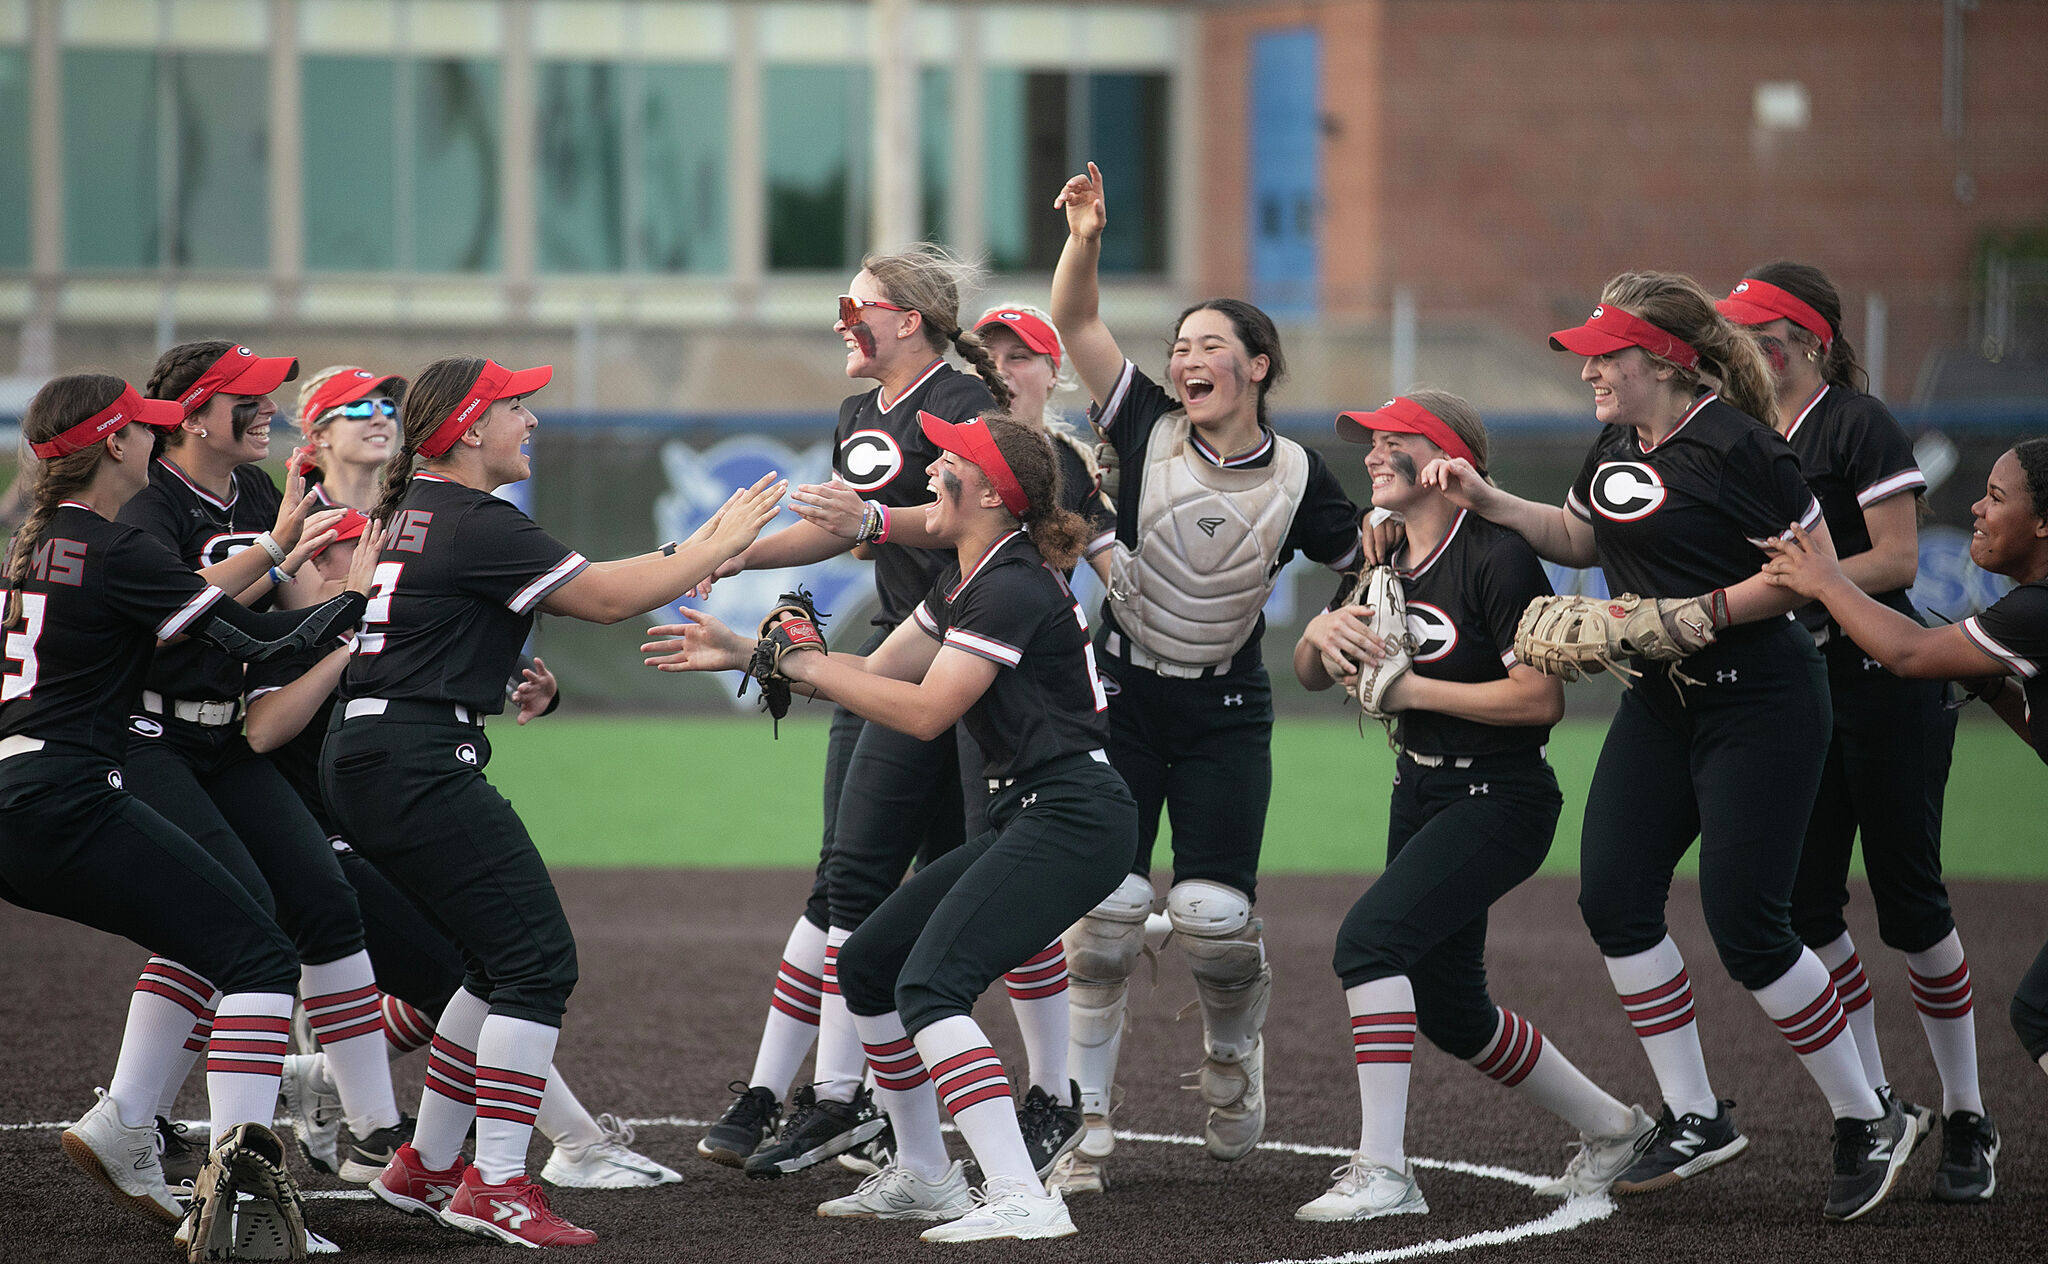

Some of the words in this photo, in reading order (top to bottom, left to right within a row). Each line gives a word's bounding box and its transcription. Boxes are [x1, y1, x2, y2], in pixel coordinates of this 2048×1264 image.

[96, 412, 123, 432] SOFTBALL
[457, 398, 481, 423] SOFTBALL
[840, 433, 893, 486] C
[1591, 463, 1656, 515] C
[0, 588, 49, 703] 3
